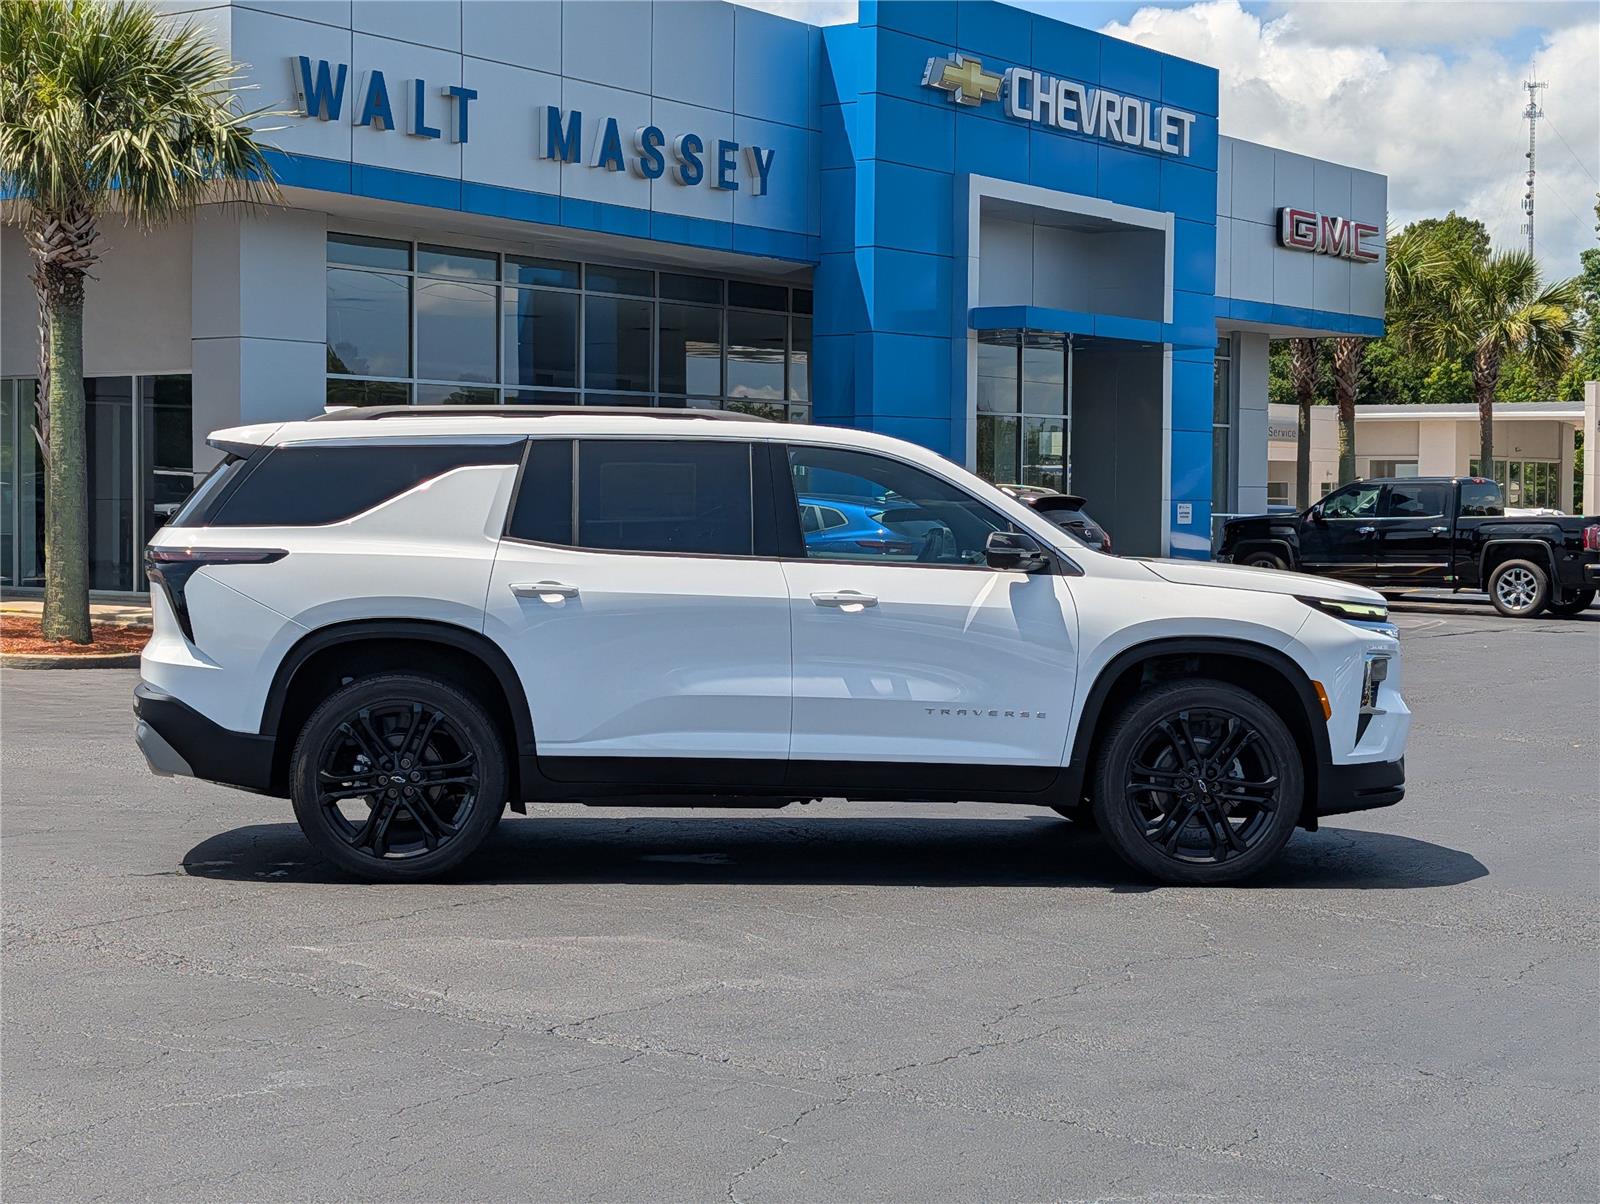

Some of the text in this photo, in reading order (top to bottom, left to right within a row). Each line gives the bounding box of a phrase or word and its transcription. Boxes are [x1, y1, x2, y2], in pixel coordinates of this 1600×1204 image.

[291, 55, 776, 197] WALT MASSEY
[1006, 67, 1196, 157] CHEVROLET
[1277, 207, 1381, 264] GMC
[1268, 426, 1297, 438] Service
[925, 708, 1046, 719] TRAVERSE
